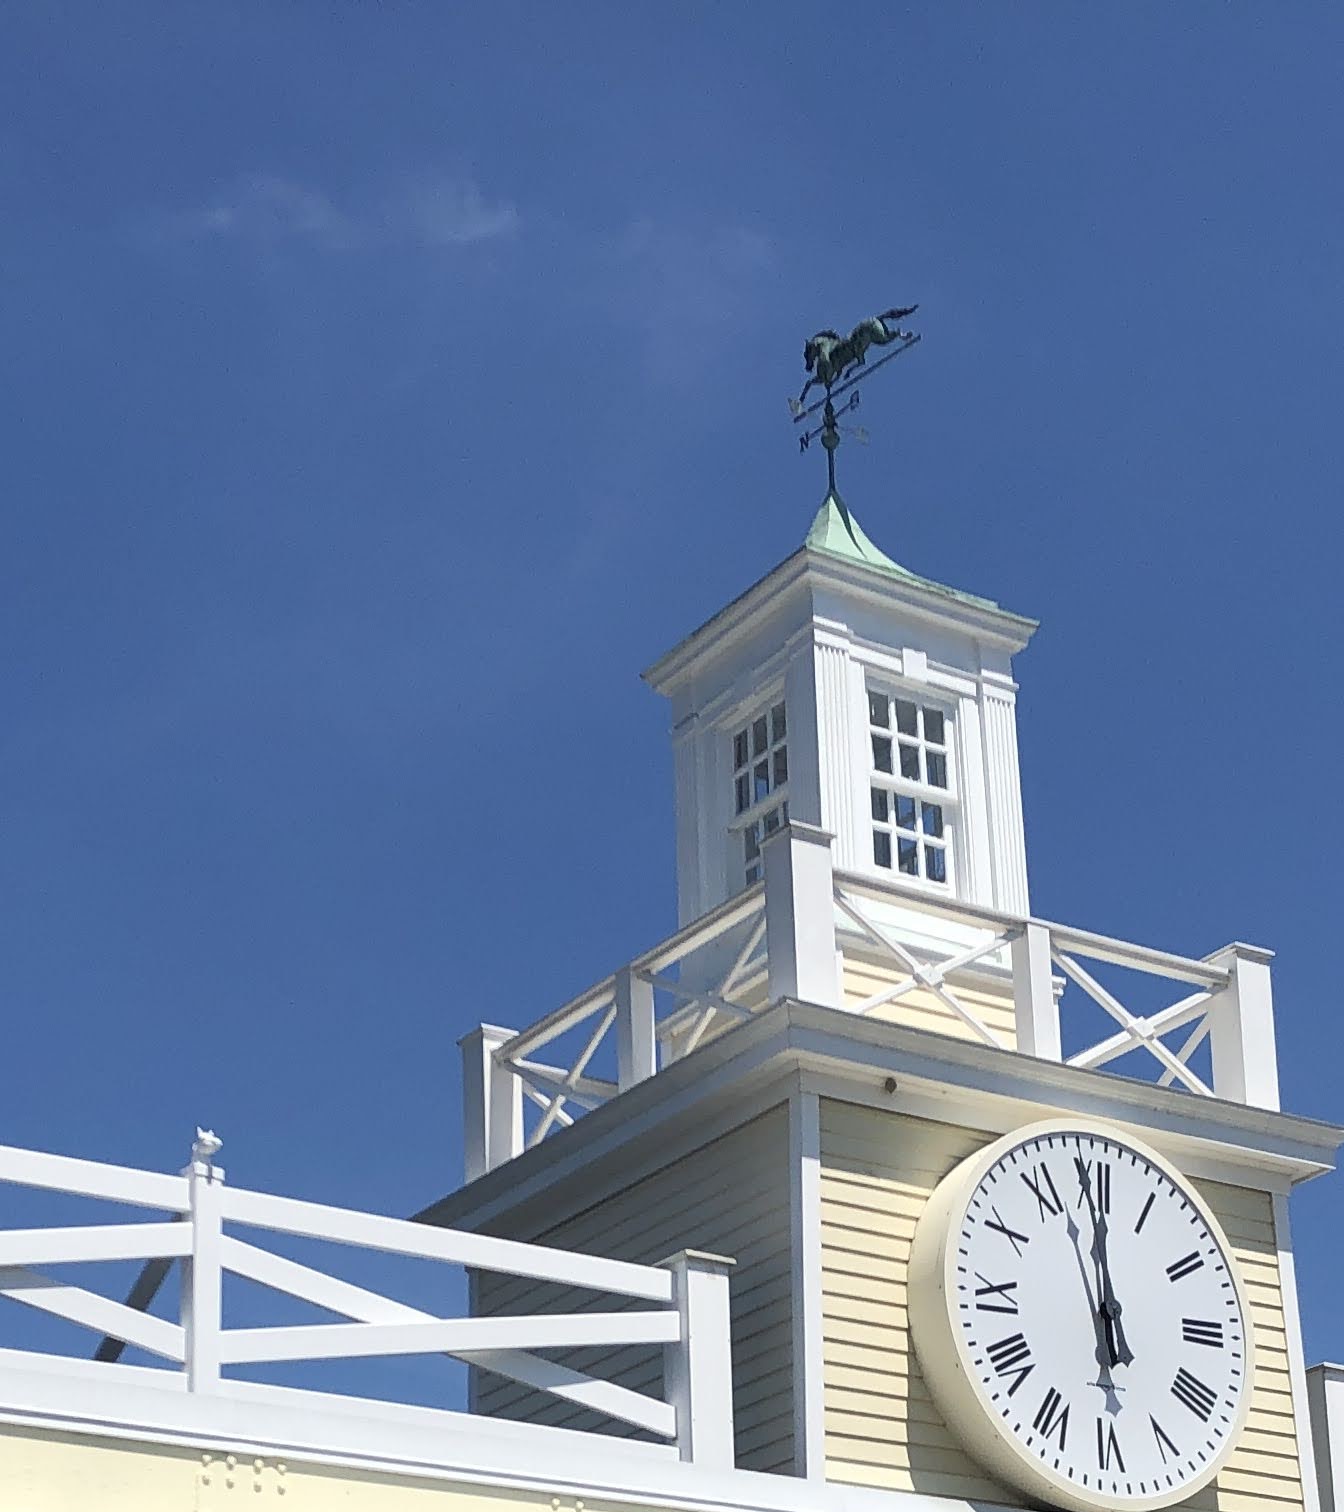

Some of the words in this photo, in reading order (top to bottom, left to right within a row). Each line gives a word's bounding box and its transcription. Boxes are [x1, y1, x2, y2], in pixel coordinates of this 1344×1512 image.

[1020, 1161, 1065, 1224] XI
[1134, 1192, 1156, 1234] I
[984, 1205, 1030, 1258] X
[975, 1271, 1019, 1315] IX
[1166, 1250, 1205, 1283] II
[1182, 1317, 1224, 1348] III
[986, 1333, 1036, 1397] VIII
[1032, 1386, 1071, 1453] VII
[1170, 1366, 1218, 1423] IIII
[1096, 1417, 1126, 1473] VI
[1149, 1411, 1181, 1464] V
